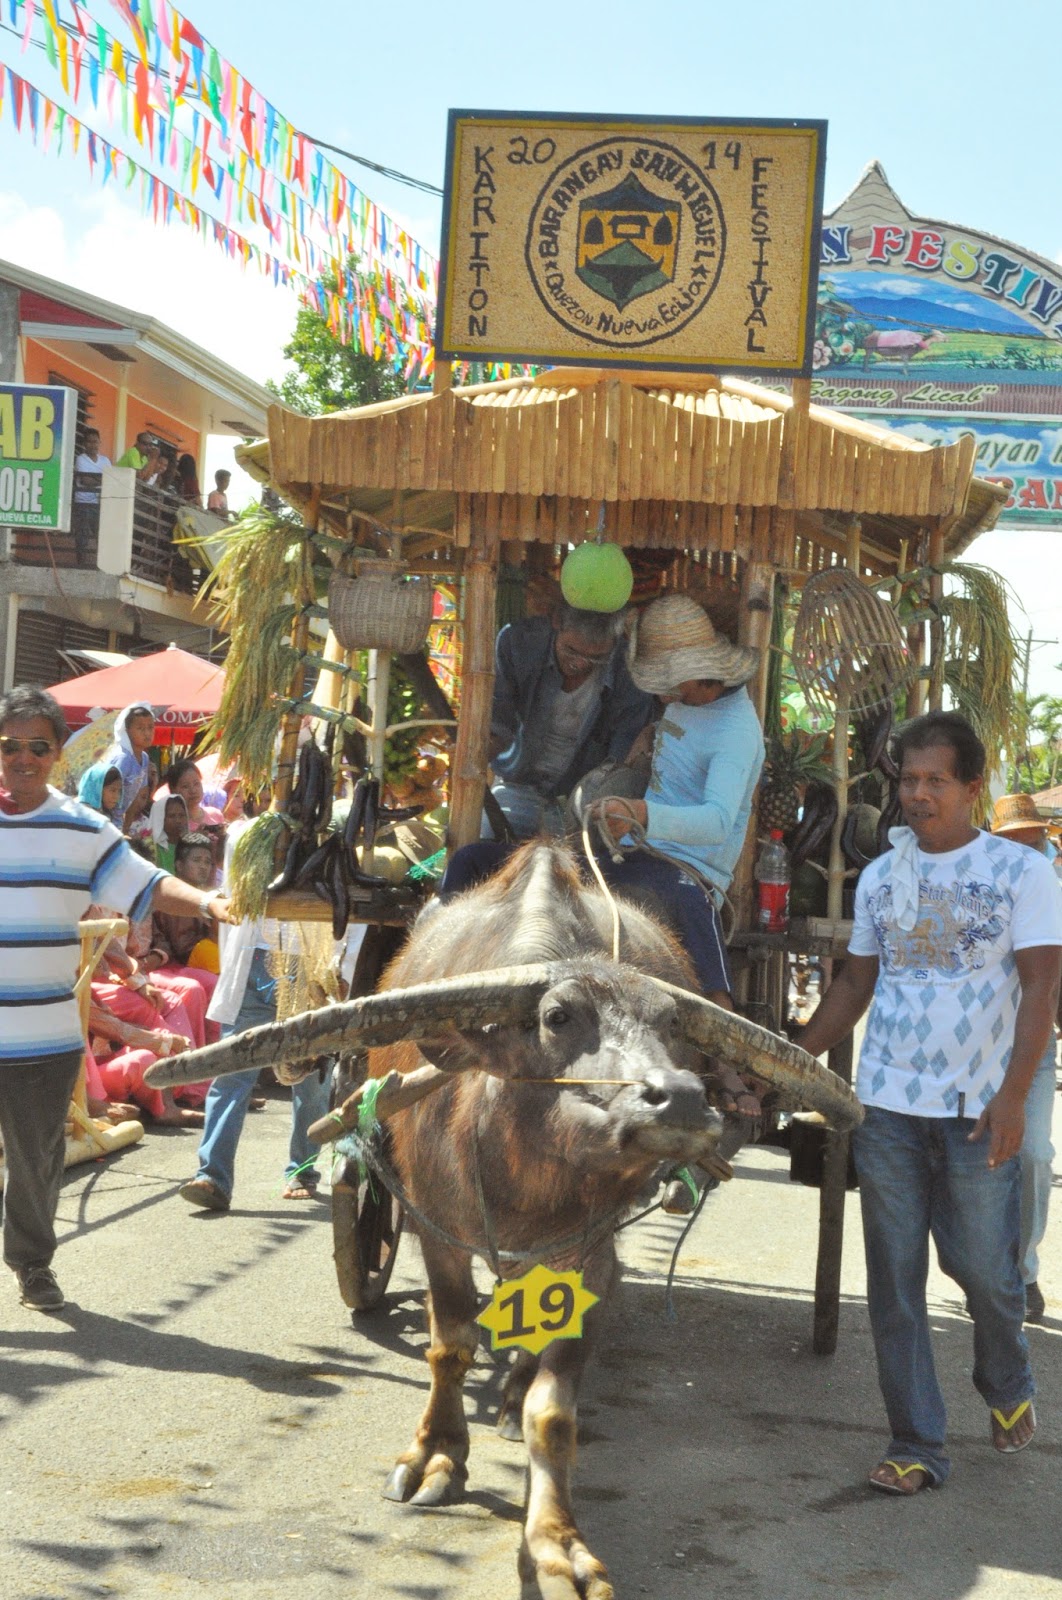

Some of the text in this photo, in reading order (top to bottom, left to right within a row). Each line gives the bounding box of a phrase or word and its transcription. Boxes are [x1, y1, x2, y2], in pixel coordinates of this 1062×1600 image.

[508, 136, 742, 171] 20 14
[538, 148, 716, 262] BARANGAY SAN MIGUEL
[468, 145, 497, 337] KARITON
[743, 157, 774, 353] FESTIVAL
[866, 224, 1062, 338] FESTIV
[497, 1282, 575, 1341] 19
